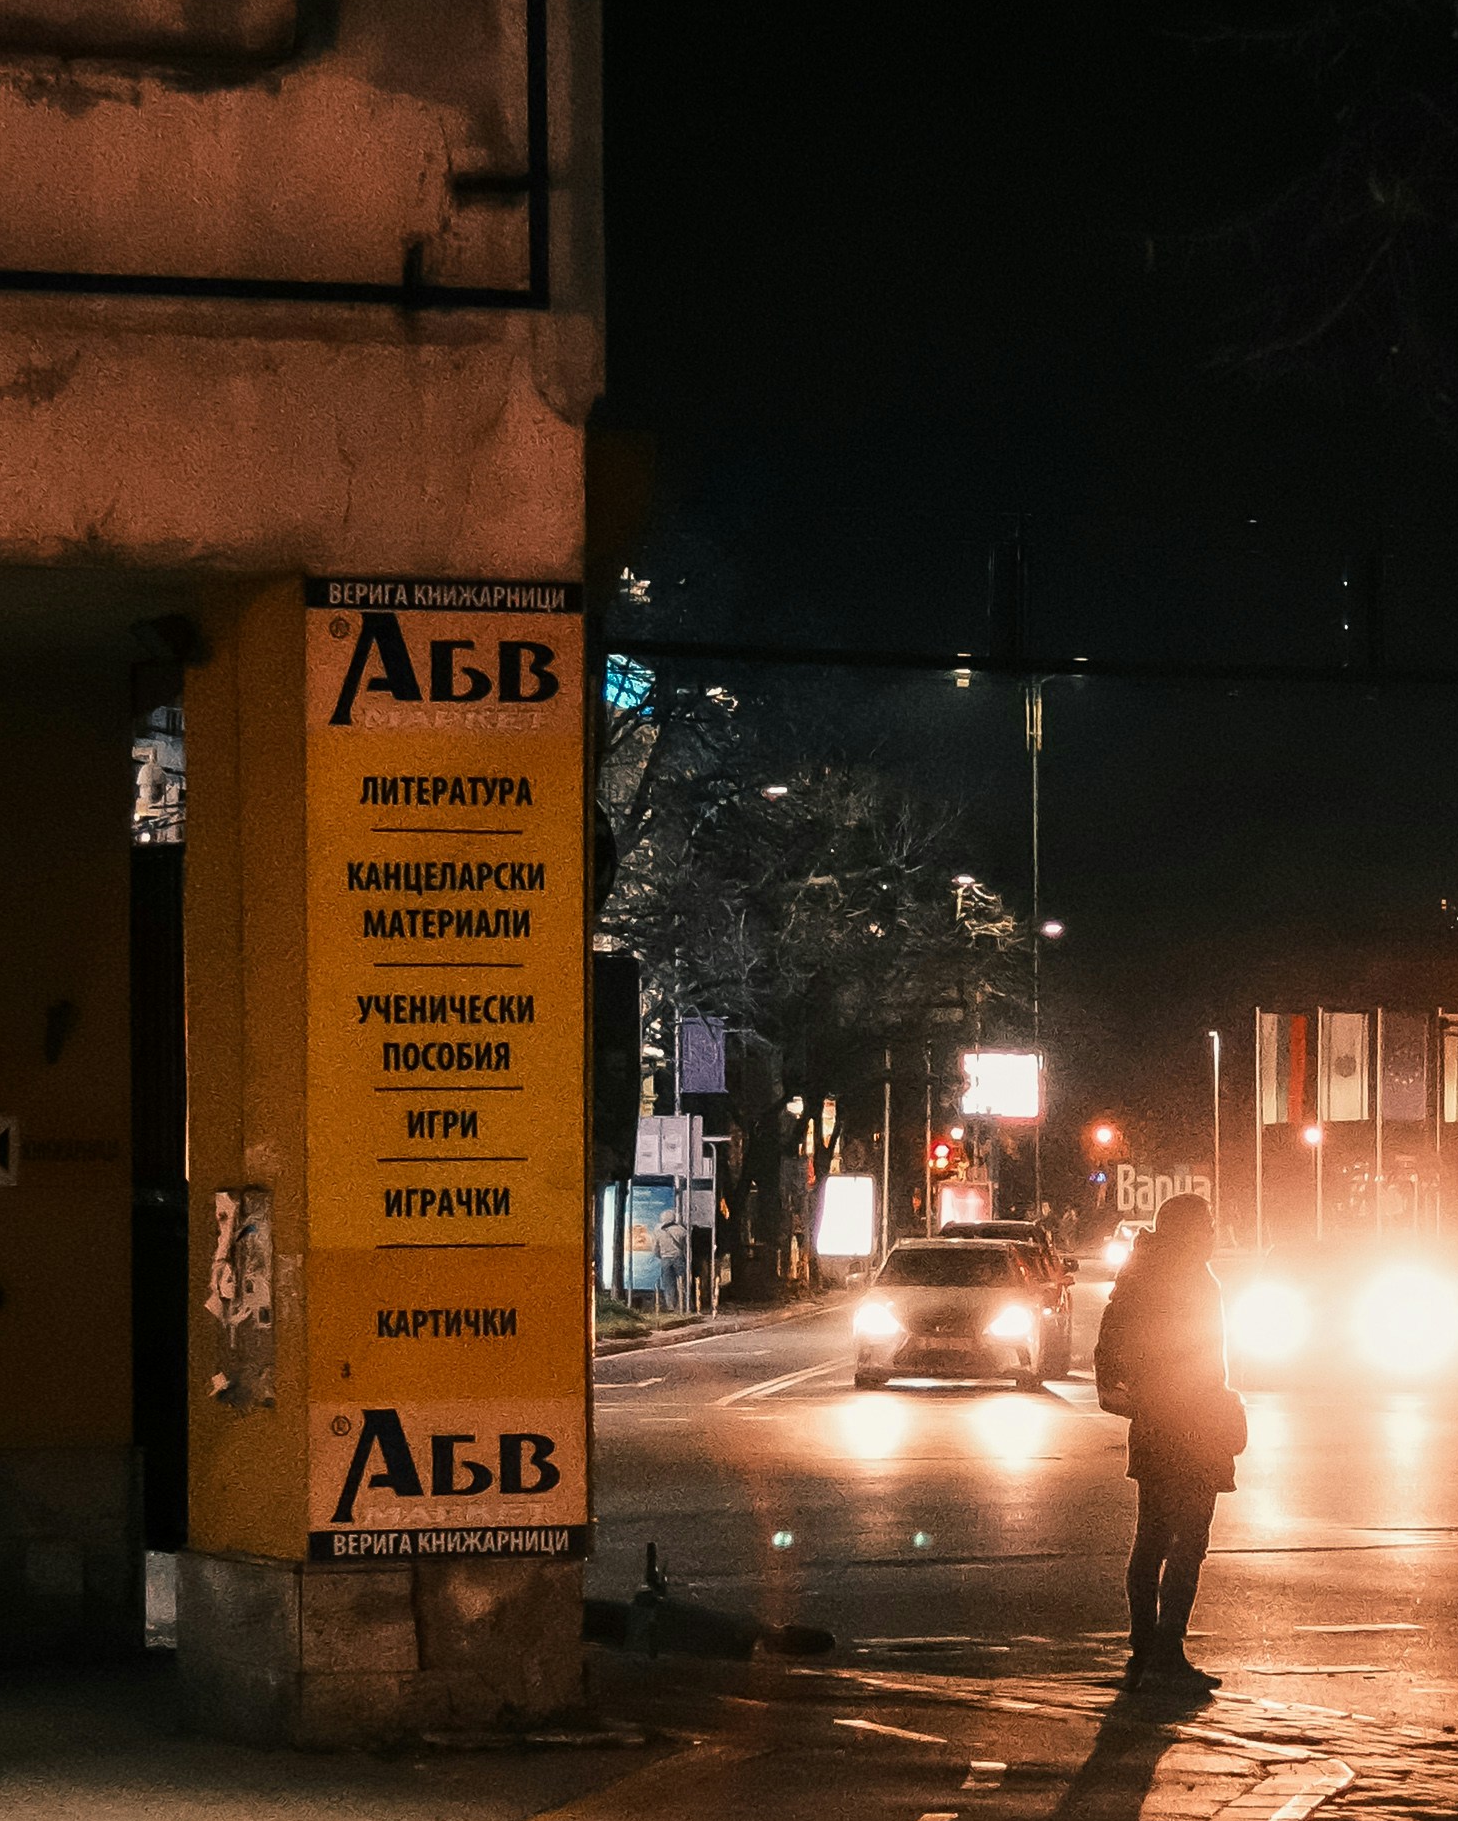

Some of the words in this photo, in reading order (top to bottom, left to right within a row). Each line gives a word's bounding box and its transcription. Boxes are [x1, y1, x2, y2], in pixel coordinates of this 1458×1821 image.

[328, 581, 409, 606] ВЕРИГА
[414, 583, 566, 611] КНИЖАРНИЦИ
[359, 776, 533, 806] ЛИТЕРАТУРА
[347, 862, 545, 895] КАНЦЕЛАРСКИ
[363, 908, 531, 938] МАТЕРИАЛИ
[357, 994, 535, 1024] УЧЕНИЧЕСКИ
[382, 1042, 510, 1071] ПОСОБИЯ
[407, 1110, 479, 1139] ИГРИ
[384, 1187, 511, 1217] ИГРАЧКИ
[377, 1308, 517, 1338] КАРТИЧКИ
[332, 1532, 412, 1557] ВЕРИГА
[417, 1530, 570, 1556] КНИЖАРНИЦИ
